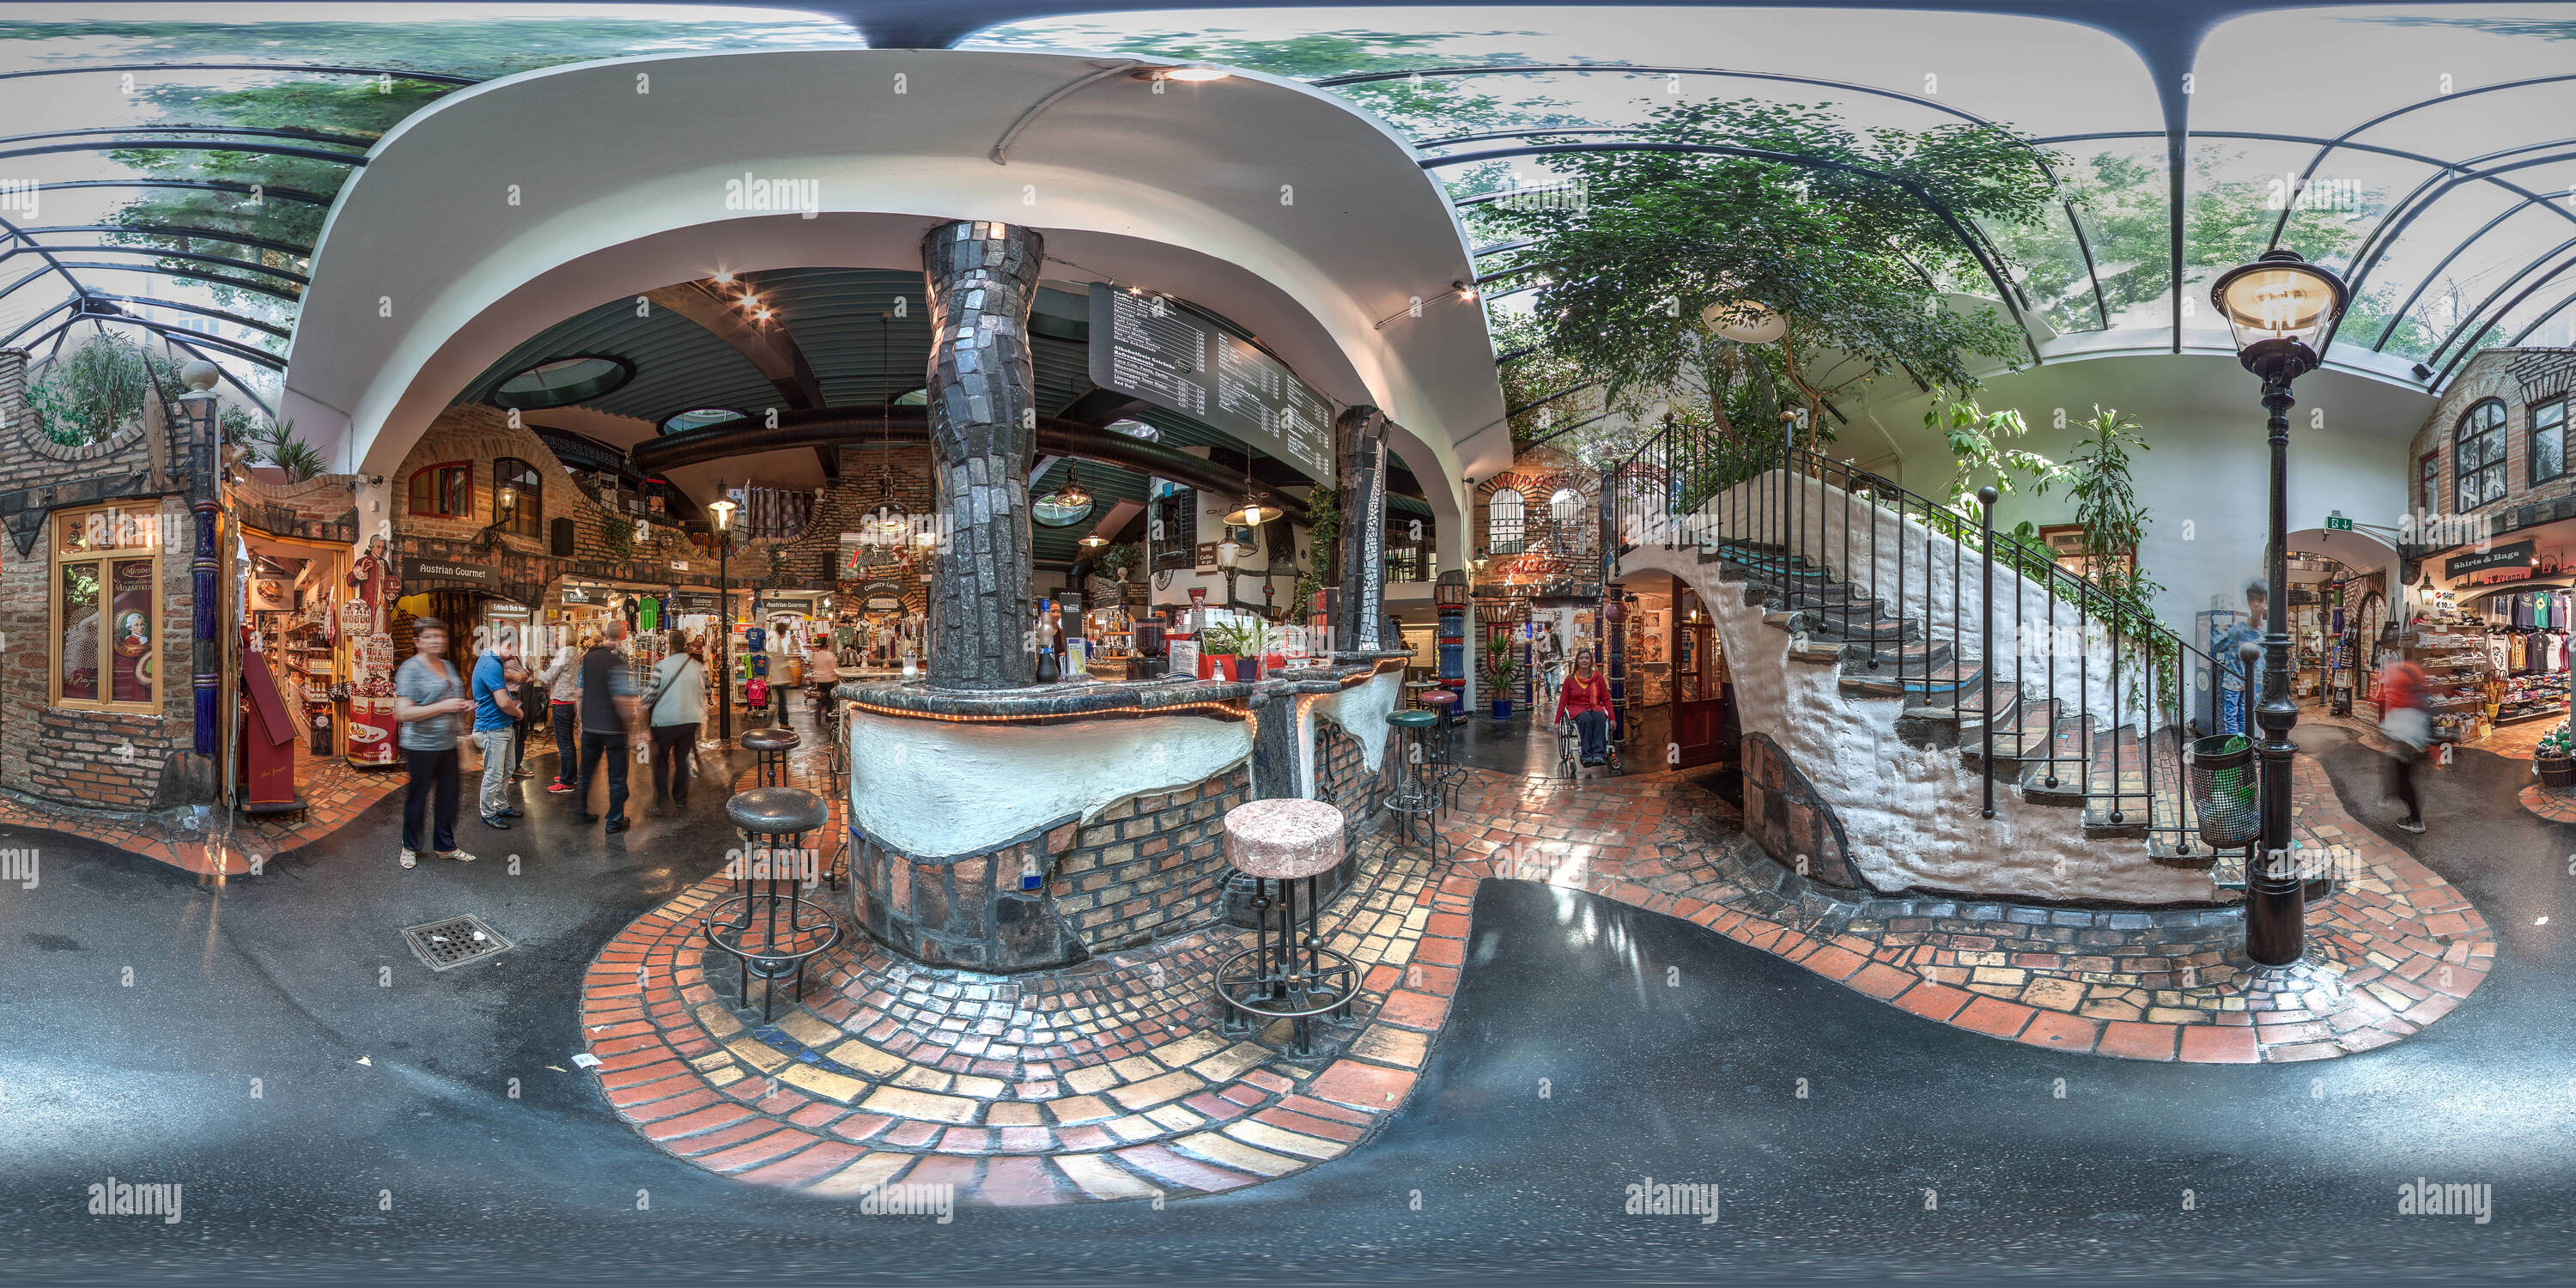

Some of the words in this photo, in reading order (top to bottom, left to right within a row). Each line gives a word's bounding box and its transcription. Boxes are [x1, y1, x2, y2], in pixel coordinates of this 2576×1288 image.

[1114, 294, 1133, 303] Coffee
[1114, 343, 1150, 360] Alkoholfreie
[1114, 349, 1153, 367] Refreshments
[1495, 560, 1569, 575] GALLERY
[2453, 558, 2482, 570] Shirts
[2494, 550, 2519, 562] Bags
[420, 564, 453, 575] Austrian
[455, 567, 486, 579] Gourmet
[2499, 573, 2525, 583] Vienna
[864, 582, 885, 592] Country
